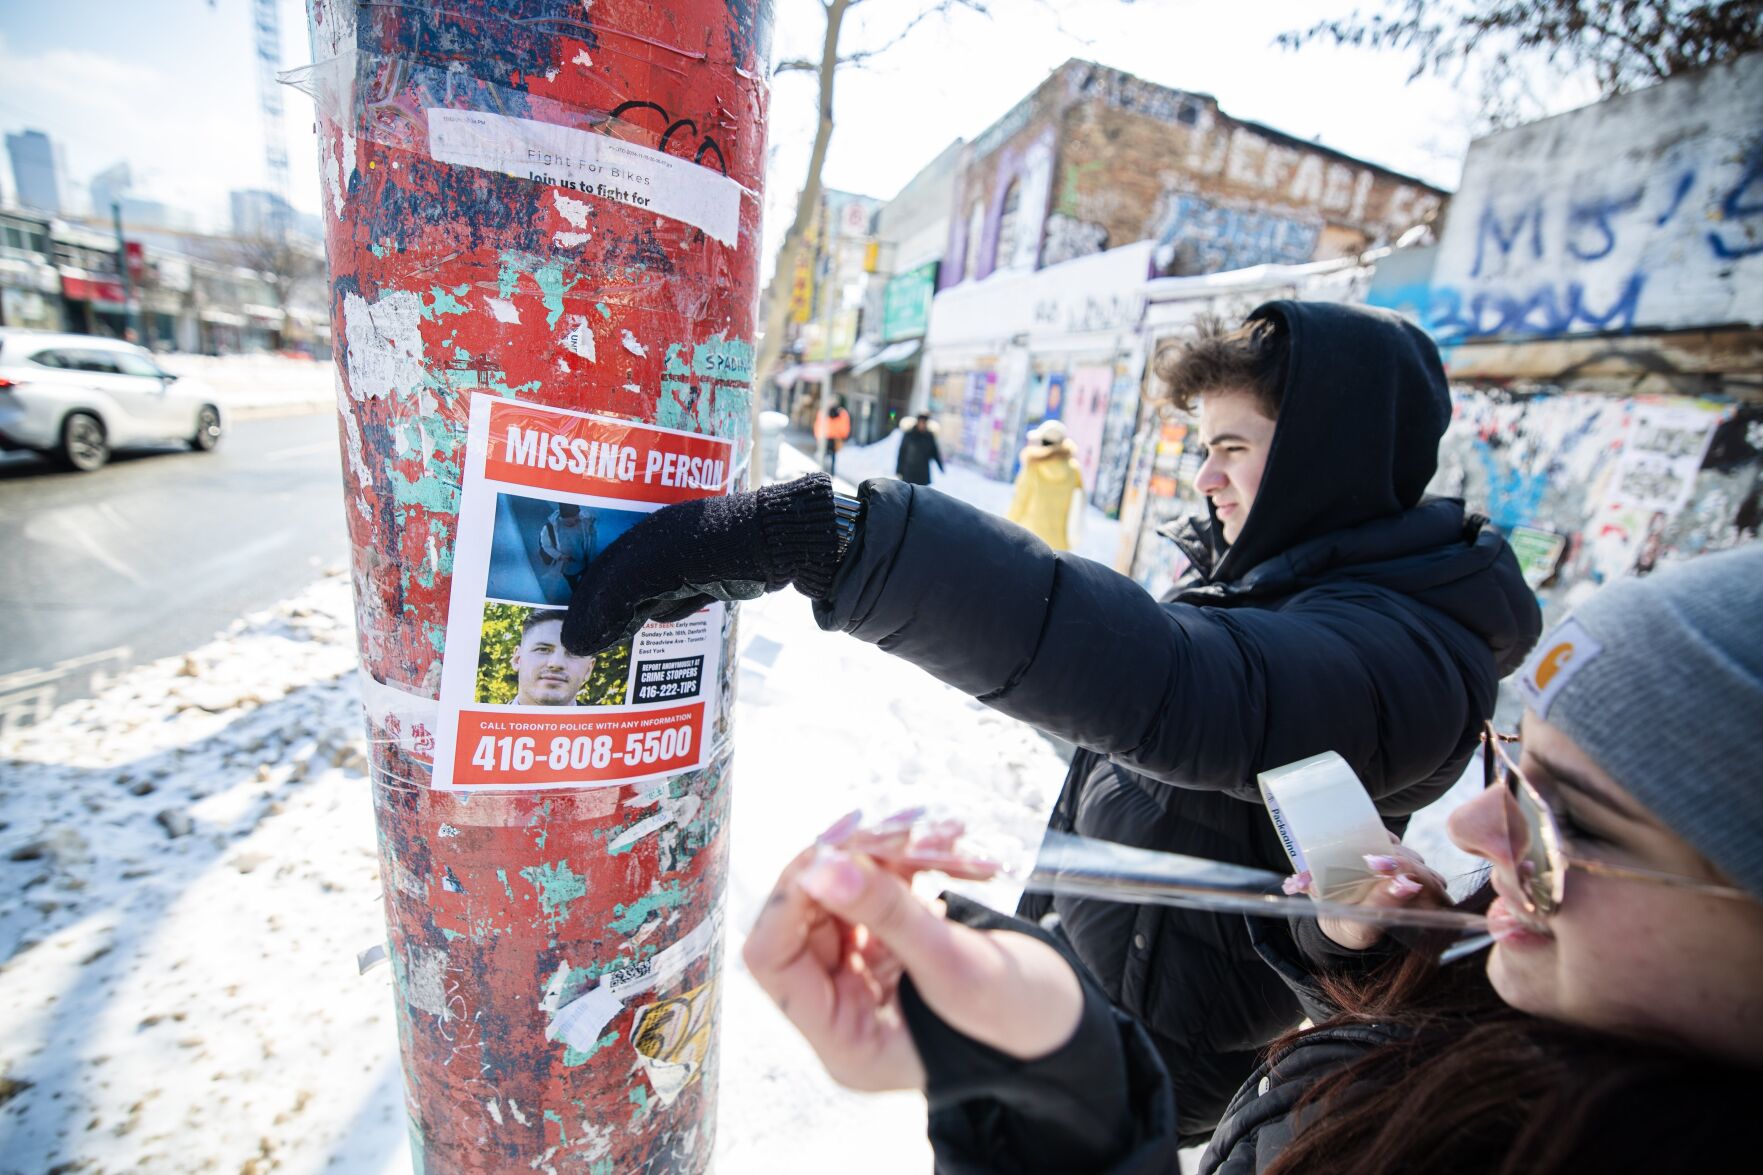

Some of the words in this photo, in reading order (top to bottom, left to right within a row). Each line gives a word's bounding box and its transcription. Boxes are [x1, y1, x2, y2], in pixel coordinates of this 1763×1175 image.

[528, 149, 571, 166] Fight
[579, 159, 603, 174] For
[611, 167, 650, 185] Bikes
[529, 171, 557, 185] Join
[560, 179, 576, 189] us
[580, 181, 594, 193] to
[597, 184, 629, 201] fight
[632, 192, 651, 206] for
[504, 426, 637, 482] MISSING
[644, 450, 724, 491] PERSON
[641, 671, 665, 683] CRIME
[666, 667, 698, 681] STOPPERS
[642, 664, 661, 672] REPORT
[662, 660, 694, 670] ANONYMOUSLY
[639, 680, 697, 699] 416-222-TIPS
[480, 721, 507, 730] CALL
[509, 722, 557, 731] TORONTO
[560, 722, 593, 731] POLICE
[596, 721, 619, 730] WITH
[620, 720, 640, 729] ANY
[640, 713, 692, 727] INFORMATION
[472, 725, 693, 771] 416-808-5500
